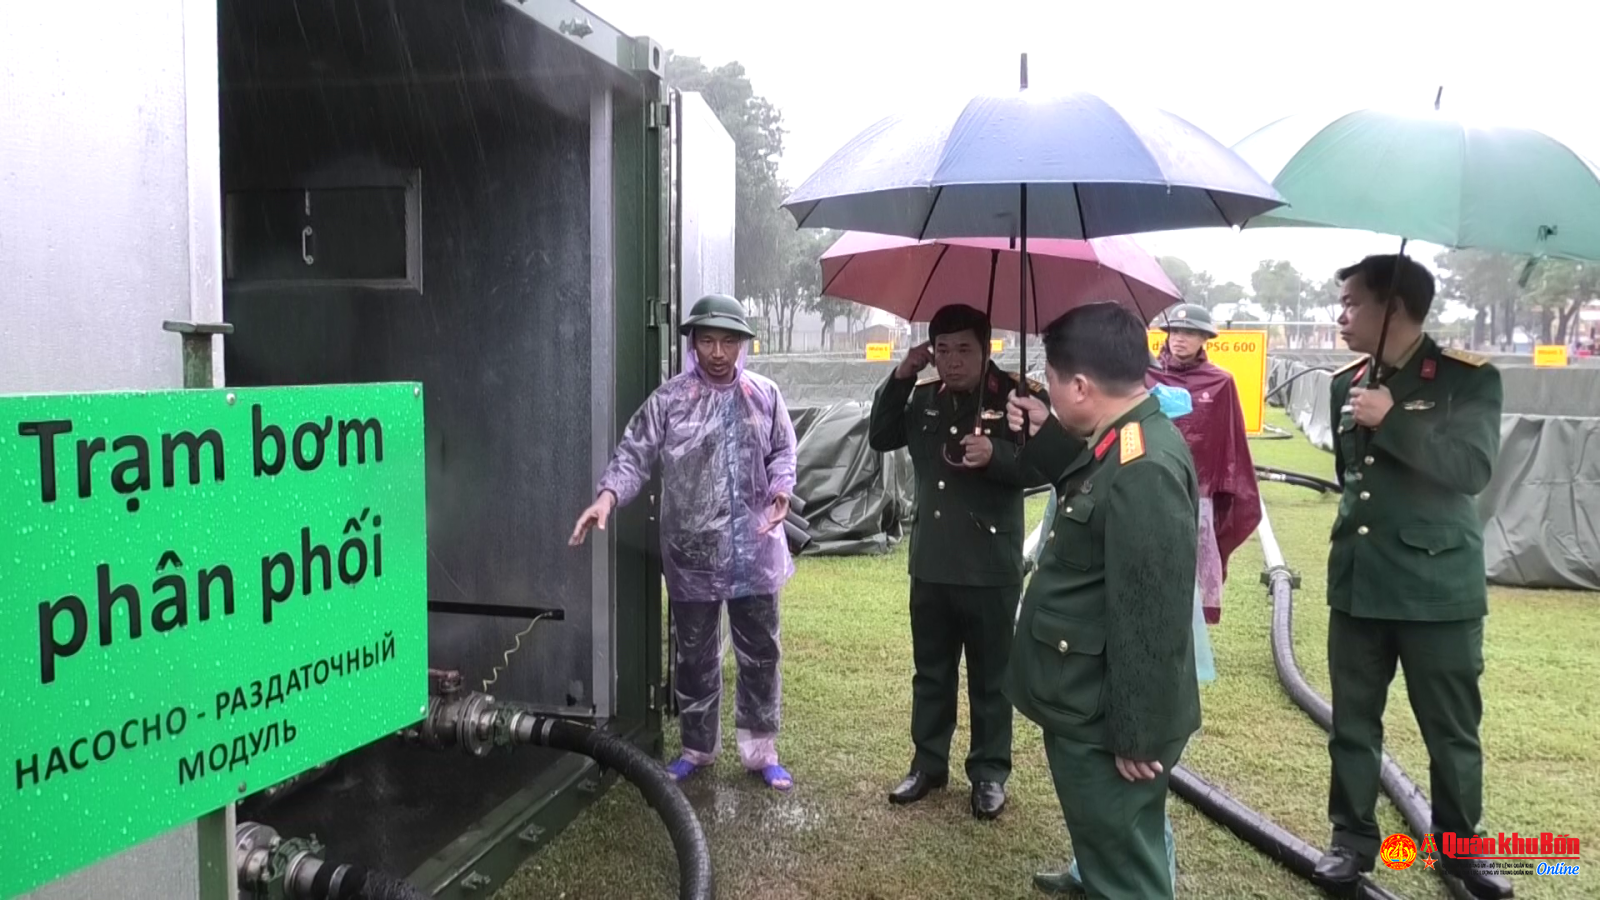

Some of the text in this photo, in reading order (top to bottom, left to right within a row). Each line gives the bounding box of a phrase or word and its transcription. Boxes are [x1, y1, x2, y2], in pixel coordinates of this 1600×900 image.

[1206, 341, 1229, 352] PSG
[1233, 341, 1256, 352] 600
[18, 403, 383, 512] Trạm bơm
[38, 507, 382, 684] phân phối
[15, 706, 188, 790] НАСОСНО
[215, 630, 396, 720] РАЗДАТОЧНЫЙ
[178, 718, 297, 786] МОДУЛЬ
